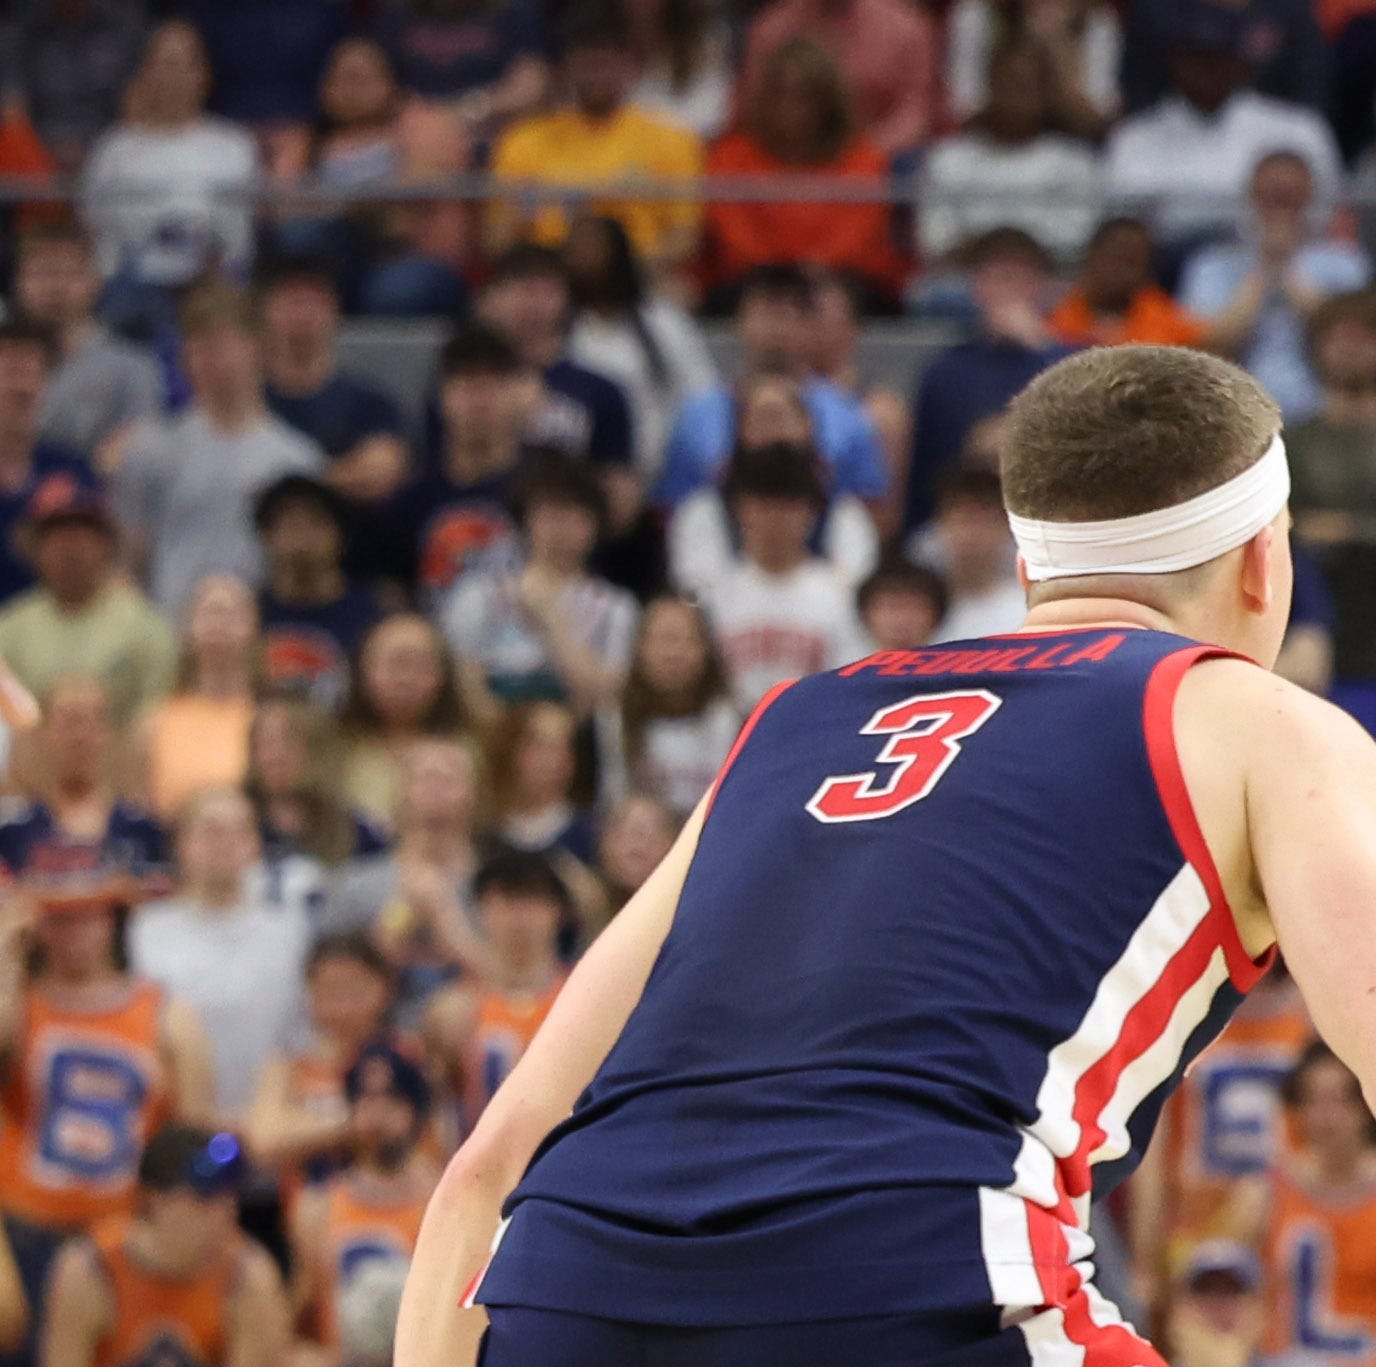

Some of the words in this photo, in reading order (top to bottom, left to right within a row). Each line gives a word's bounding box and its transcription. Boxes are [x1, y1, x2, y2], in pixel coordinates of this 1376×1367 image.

[838, 634, 1127, 677] PEDULLA
[805, 688, 1003, 824] 3
[36, 1042, 152, 1180] B
[1198, 1060, 1295, 1176] E
[1286, 1236, 1368, 1360] L
